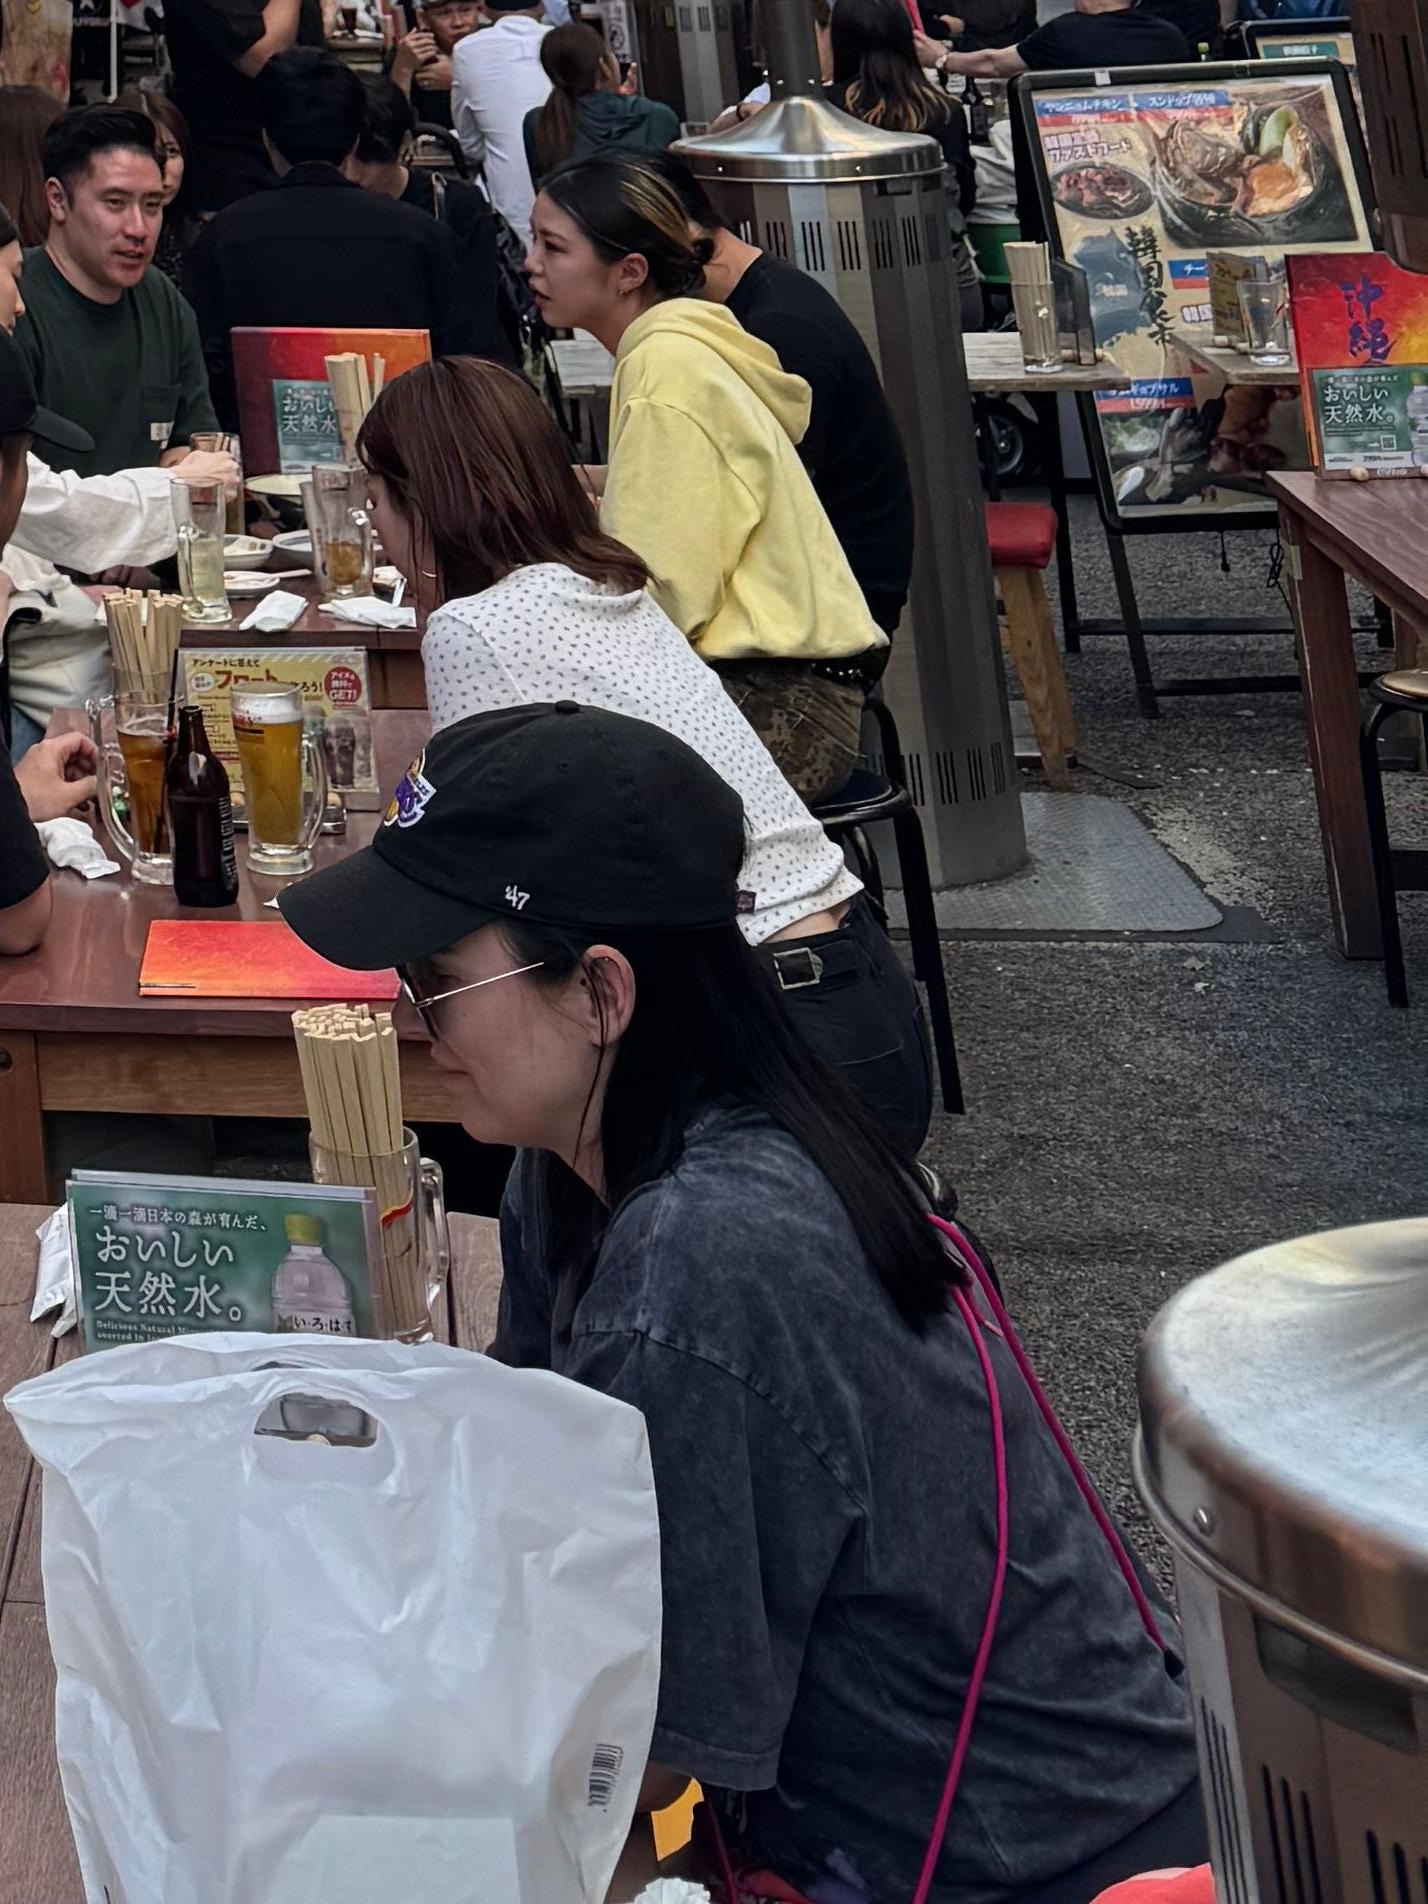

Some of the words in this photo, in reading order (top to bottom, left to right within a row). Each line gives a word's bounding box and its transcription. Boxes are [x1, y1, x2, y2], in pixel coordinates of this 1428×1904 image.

[1336, 275, 1398, 363] 沖縄
[1323, 385, 1389, 403] おいしい
[282, 414, 337, 434] 天然水
[1323, 403, 1394, 425] 天然水。
[329, 689, 358, 701] GET!
[94, 1223, 235, 1268] おいしい
[94, 1270, 243, 1323] 天然水。
